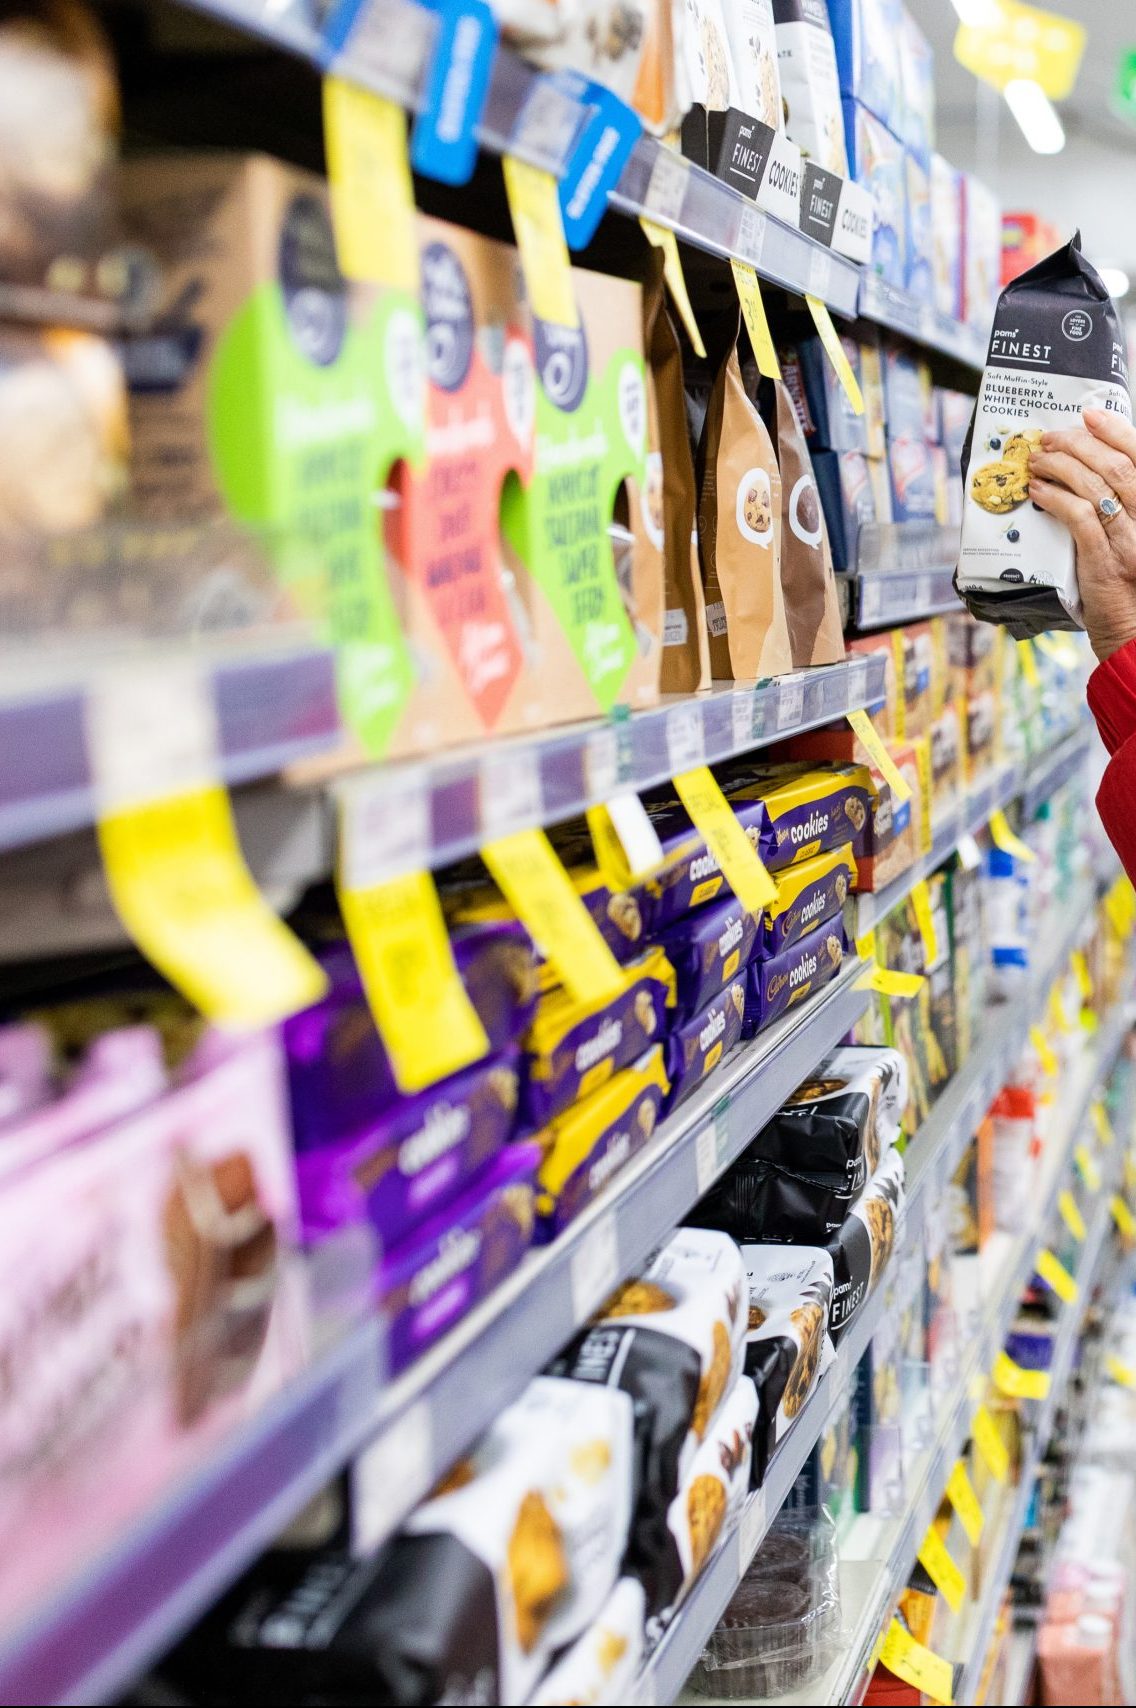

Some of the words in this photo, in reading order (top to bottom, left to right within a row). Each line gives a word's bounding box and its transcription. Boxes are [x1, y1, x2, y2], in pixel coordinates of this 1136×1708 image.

[732, 144, 763, 174] FINEST
[768, 160, 800, 198] COOKIES
[810, 195, 833, 219] FINEST
[994, 329, 1017, 338] pams
[991, 341, 1052, 359] FINEST
[986, 384, 1044, 398] BLUEBERRY
[1047, 391, 1054, 400] &
[987, 372, 1001, 381] Soft
[1004, 375, 1048, 386] Muffin-Style
[983, 405, 1030, 418] COOKIES
[984, 394, 1017, 406] WHITE
[1020, 398, 1082, 413] CHOCOLATE
[791, 810, 829, 844] cookies
[801, 890, 826, 924] cookies
[719, 916, 743, 957] cookies
[789, 952, 817, 988] cookies
[700, 1008, 726, 1052] cookies
[832, 1281, 864, 1322] FINEST
